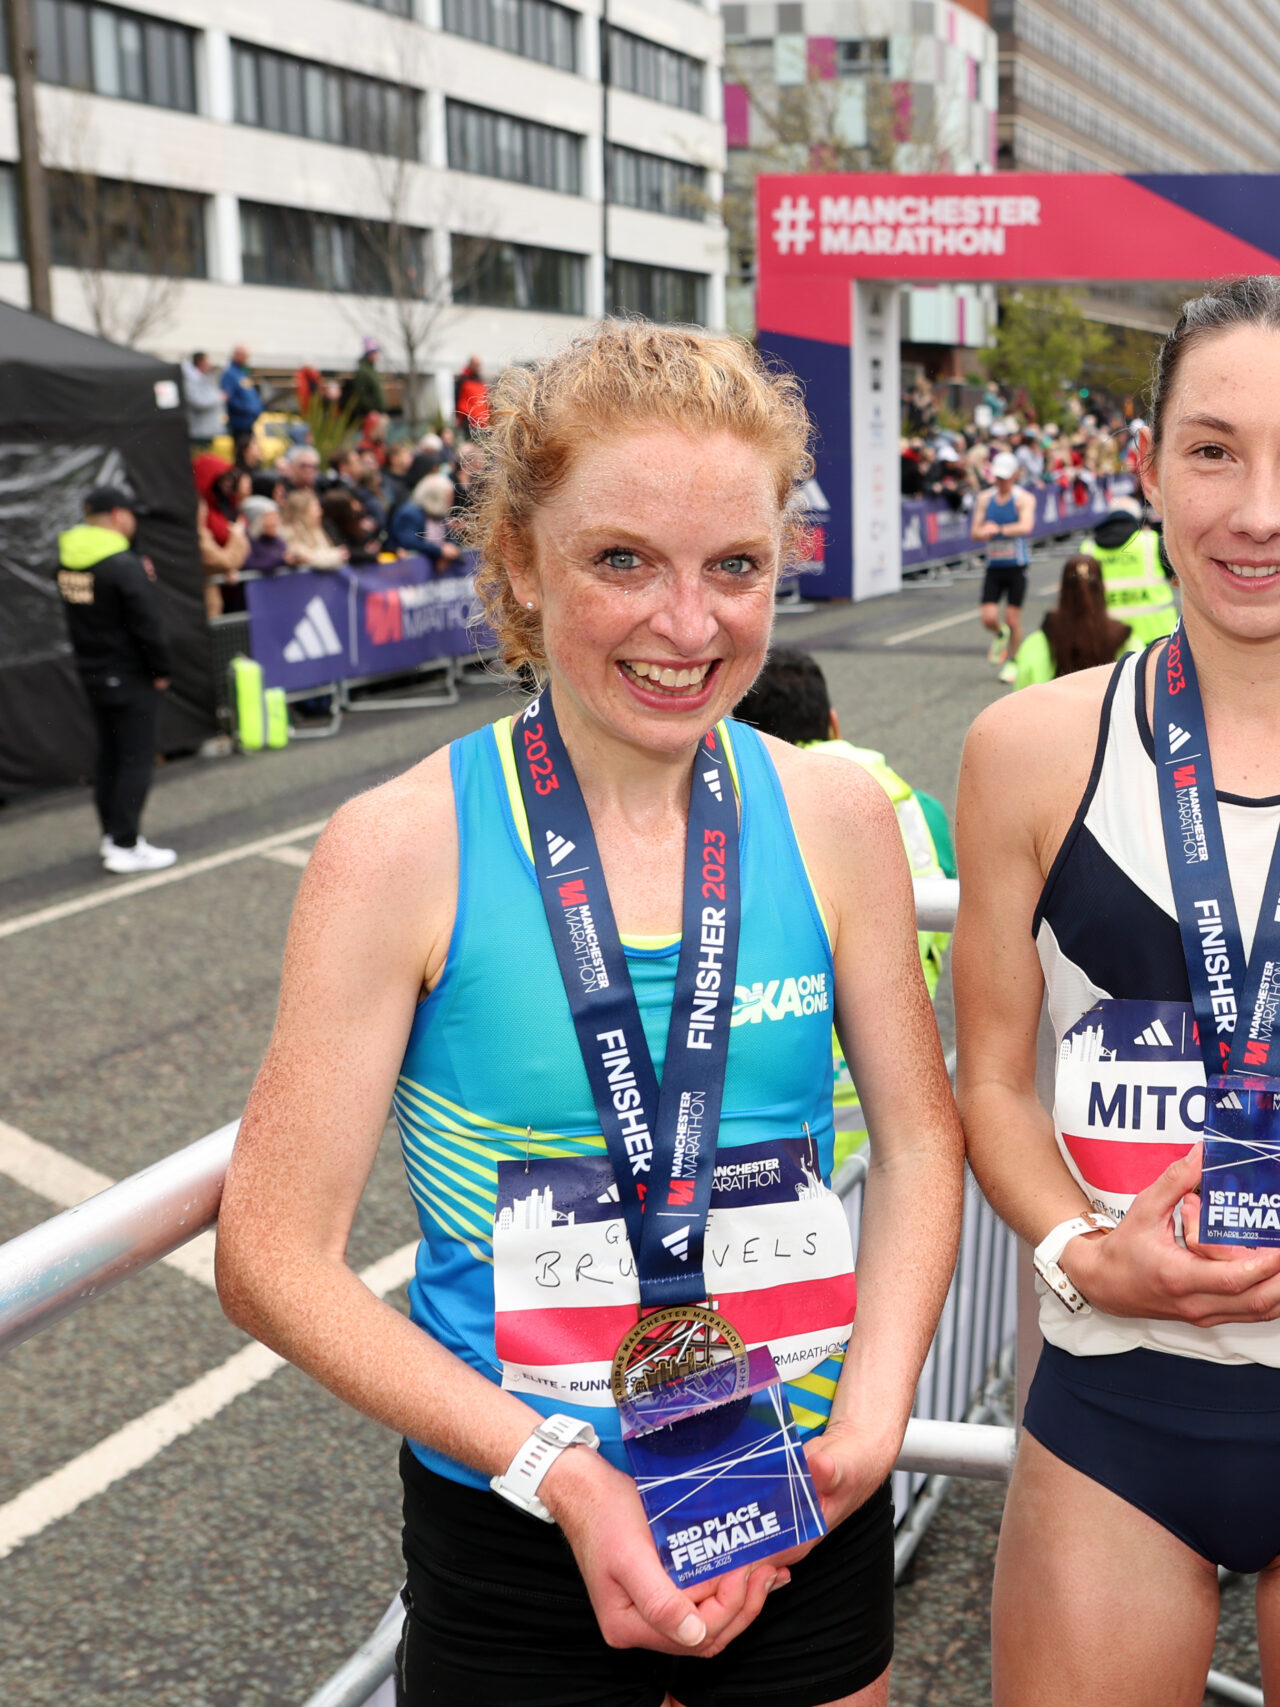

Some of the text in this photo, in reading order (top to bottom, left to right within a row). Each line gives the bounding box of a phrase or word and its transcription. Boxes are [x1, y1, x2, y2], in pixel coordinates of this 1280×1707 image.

[820, 195, 1041, 226] MANCHESTER
[820, 226, 1006, 255] MARATHON
[1166, 636, 1187, 696] 2023
[523, 723, 560, 796] 2023
[1176, 788, 1199, 865] MARATHON
[1187, 786, 1209, 862] MANCHESTER
[563, 908, 599, 994] MARATHON
[578, 904, 610, 990] MANCHESTER
[687, 829, 727, 1050] FINISHER 2023
[1194, 899, 1239, 1035] FINISHER
[730, 978, 804, 1027] OKA
[798, 973, 826, 994] ONE
[799, 992, 827, 1016] ONE
[1249, 960, 1275, 1039] MANCHESTER
[596, 1028, 653, 1177] FINISHER
[670, 1091, 692, 1178] MANCHESTER
[682, 1091, 706, 1178] MARATHON
[712, 1169, 781, 1192] ARATHON
[1209, 1190, 1236, 1206] 1ST
[535, 1232, 818, 1288] BRUVELS
[623, 1310, 688, 1352] MANCHESTER
[693, 1311, 741, 1350] MARATHON
[666, 1525, 702, 1550] 3RD
[703, 1501, 761, 1536] PLACE
[670, 1511, 781, 1571] FEMALE
